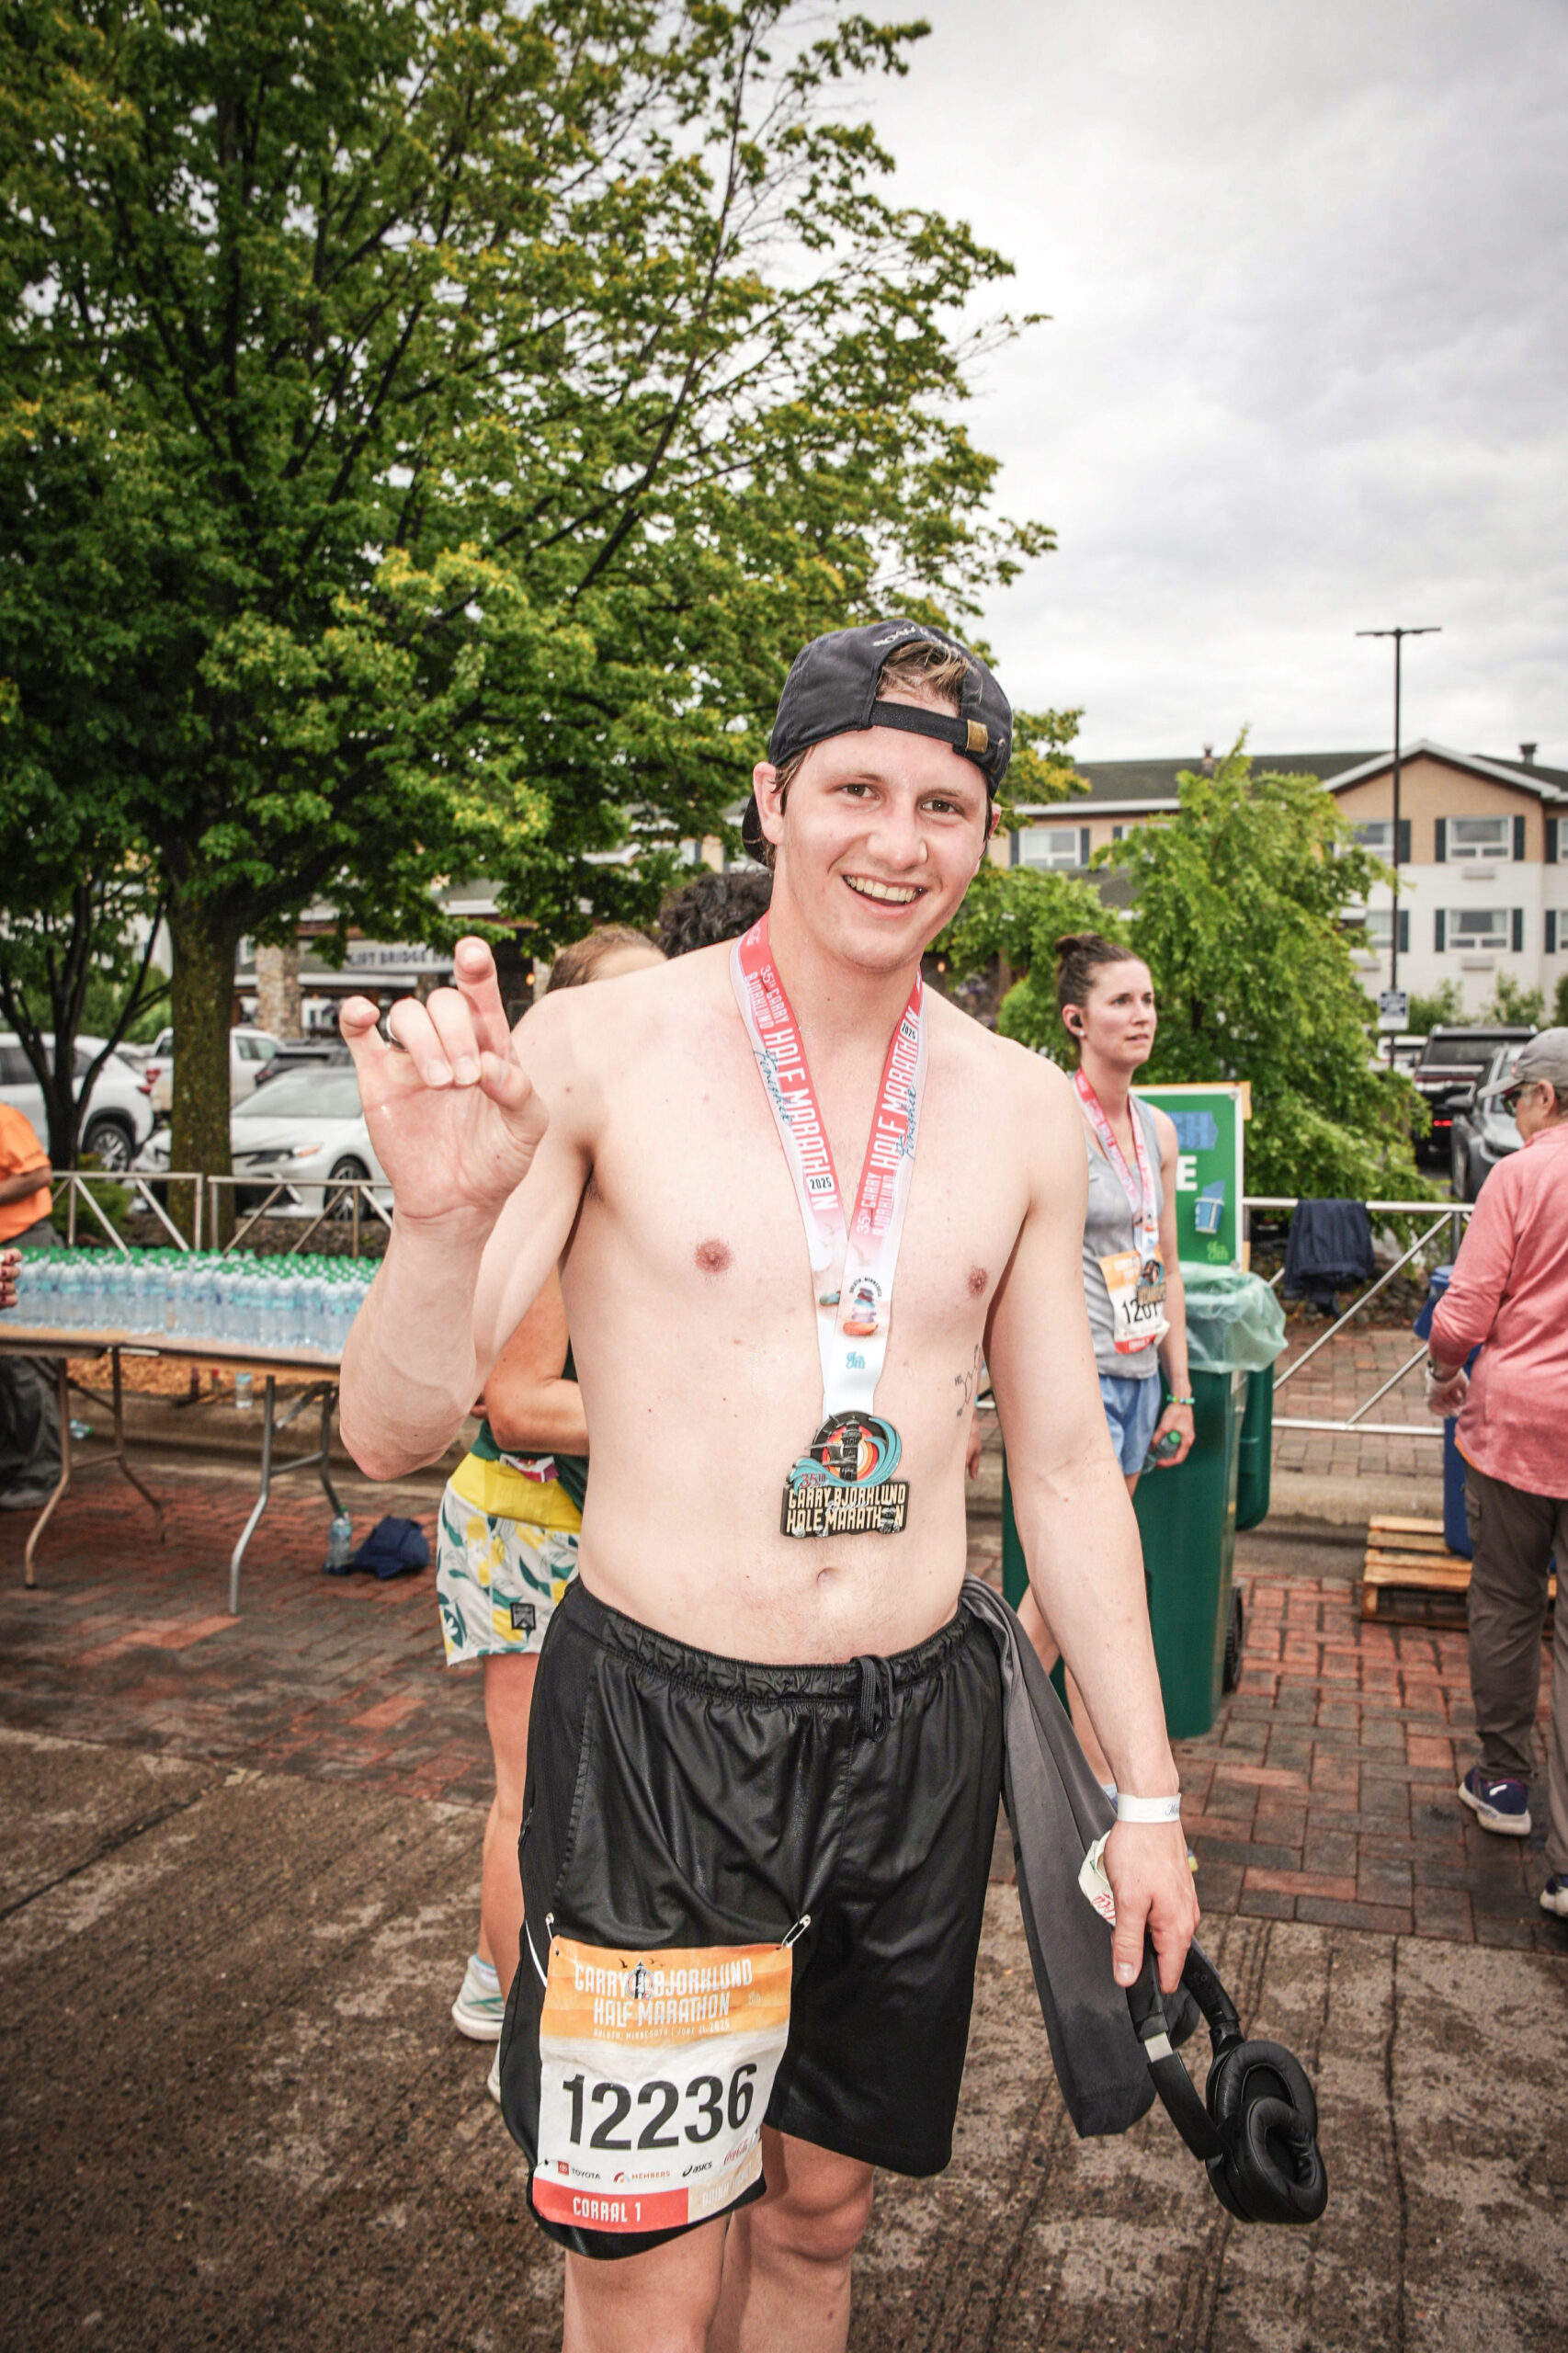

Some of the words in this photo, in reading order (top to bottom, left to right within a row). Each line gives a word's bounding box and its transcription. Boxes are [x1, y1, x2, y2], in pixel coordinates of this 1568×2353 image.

[901, 1022, 917, 1040] 2025
[764, 1027, 807, 1086] HALF
[869, 1115, 906, 1171] HALF
[809, 1176, 833, 1190] 2025
[788, 1486, 832, 1509] GARRY
[832, 1483, 906, 1507] BJORKLUND
[786, 1507, 824, 1533] HALF
[825, 1505, 904, 1531] MARATHN
[574, 1961, 630, 1998] GARRY
[653, 1958, 754, 1998] BJORKLUND
[594, 1997, 634, 2028] HALF
[637, 1991, 731, 2028] MARATHON
[709, 2018, 731, 2033] 2025
[562, 2063, 758, 2152] 12236
[571, 2167, 601, 2180] TOYOTA
[631, 2170, 671, 2180] MEMBERS
[573, 2196, 628, 2223] CORRAL
[634, 2201, 642, 2222] 1
